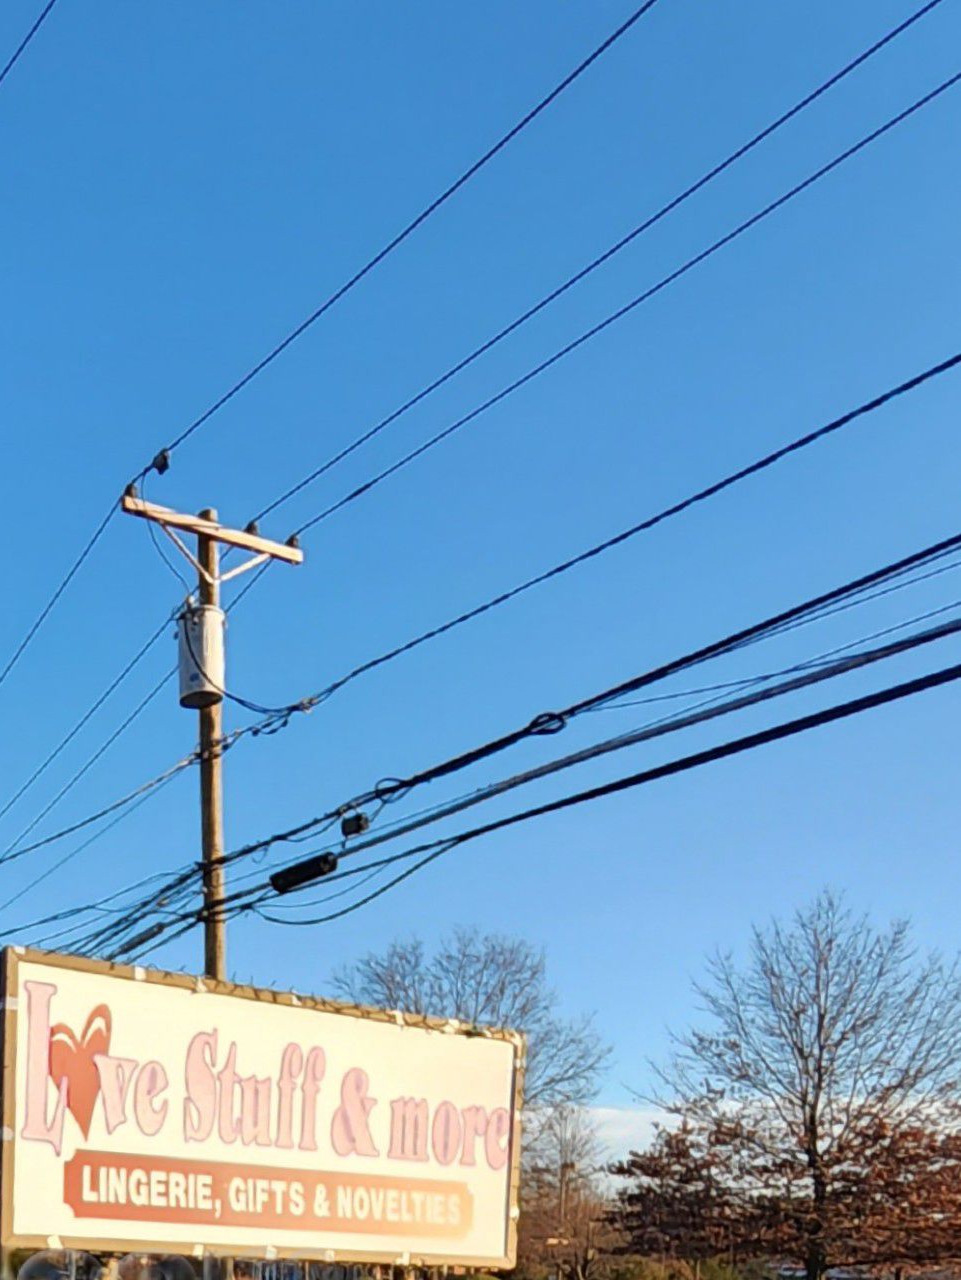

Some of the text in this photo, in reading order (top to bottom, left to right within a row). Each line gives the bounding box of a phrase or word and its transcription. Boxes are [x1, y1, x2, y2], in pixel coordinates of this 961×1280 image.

[183, 1027, 327, 1151] Stuff
[331, 1067, 380, 1158] &
[387, 1096, 510, 1171] more
[81, 1164, 462, 1226] LINGERIE, GIFTS & NOVELTIES
